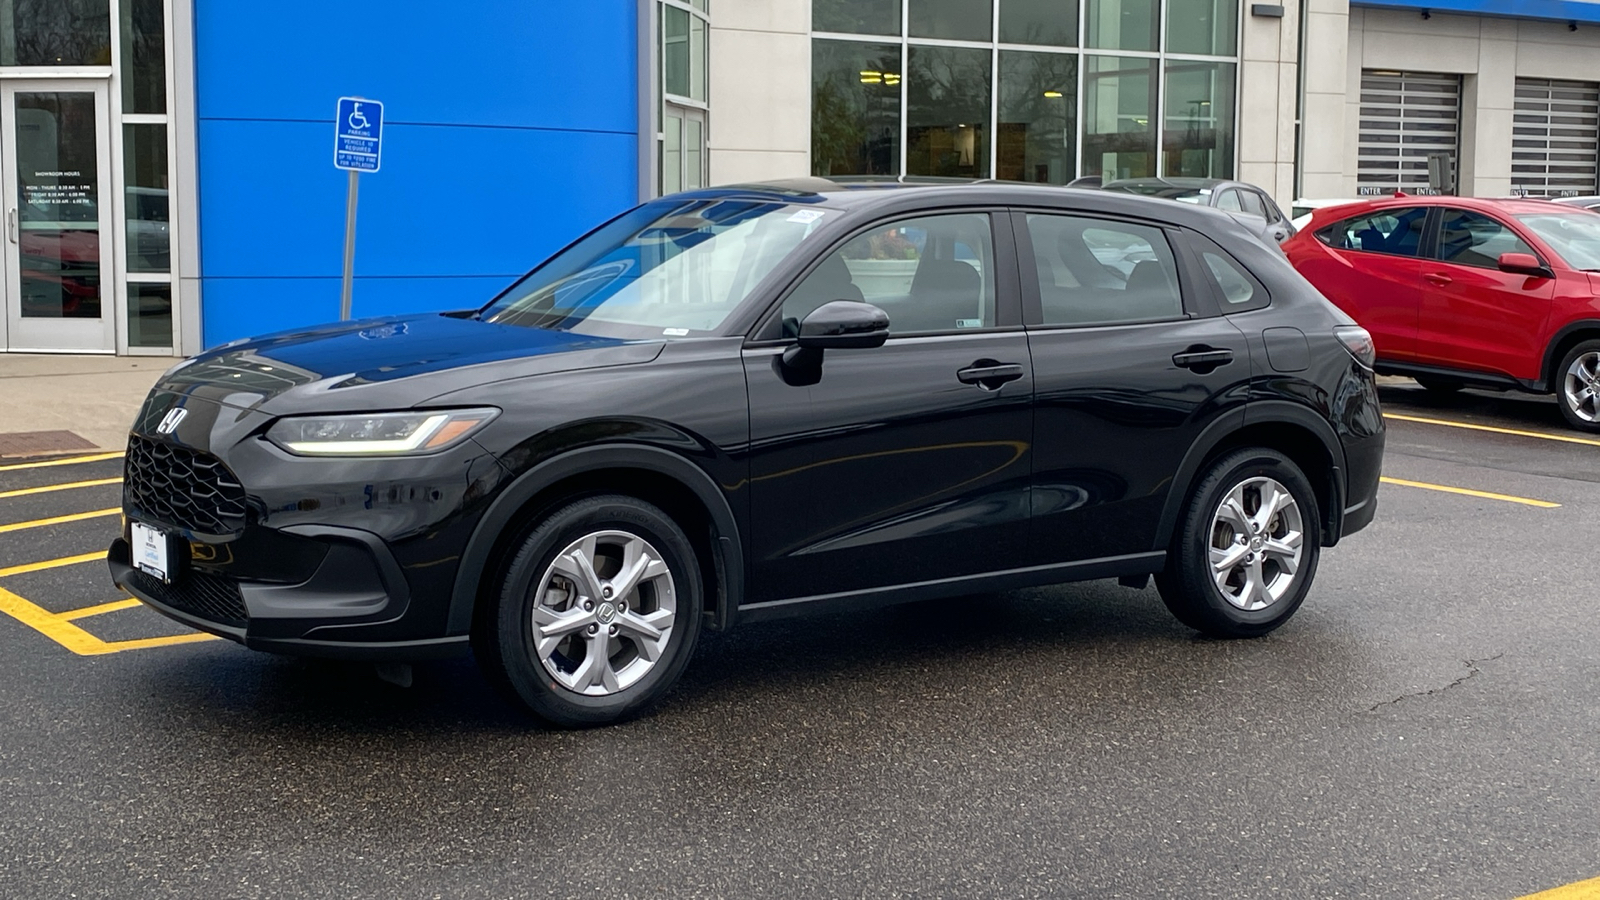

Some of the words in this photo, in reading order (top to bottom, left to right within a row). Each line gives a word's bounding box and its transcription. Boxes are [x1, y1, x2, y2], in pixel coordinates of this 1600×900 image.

[344, 138, 365, 146] VEHICLE
[345, 145, 371, 153] REQUIRED
[1360, 187, 1381, 195] ENTER
[1416, 188, 1437, 196] ENTER
